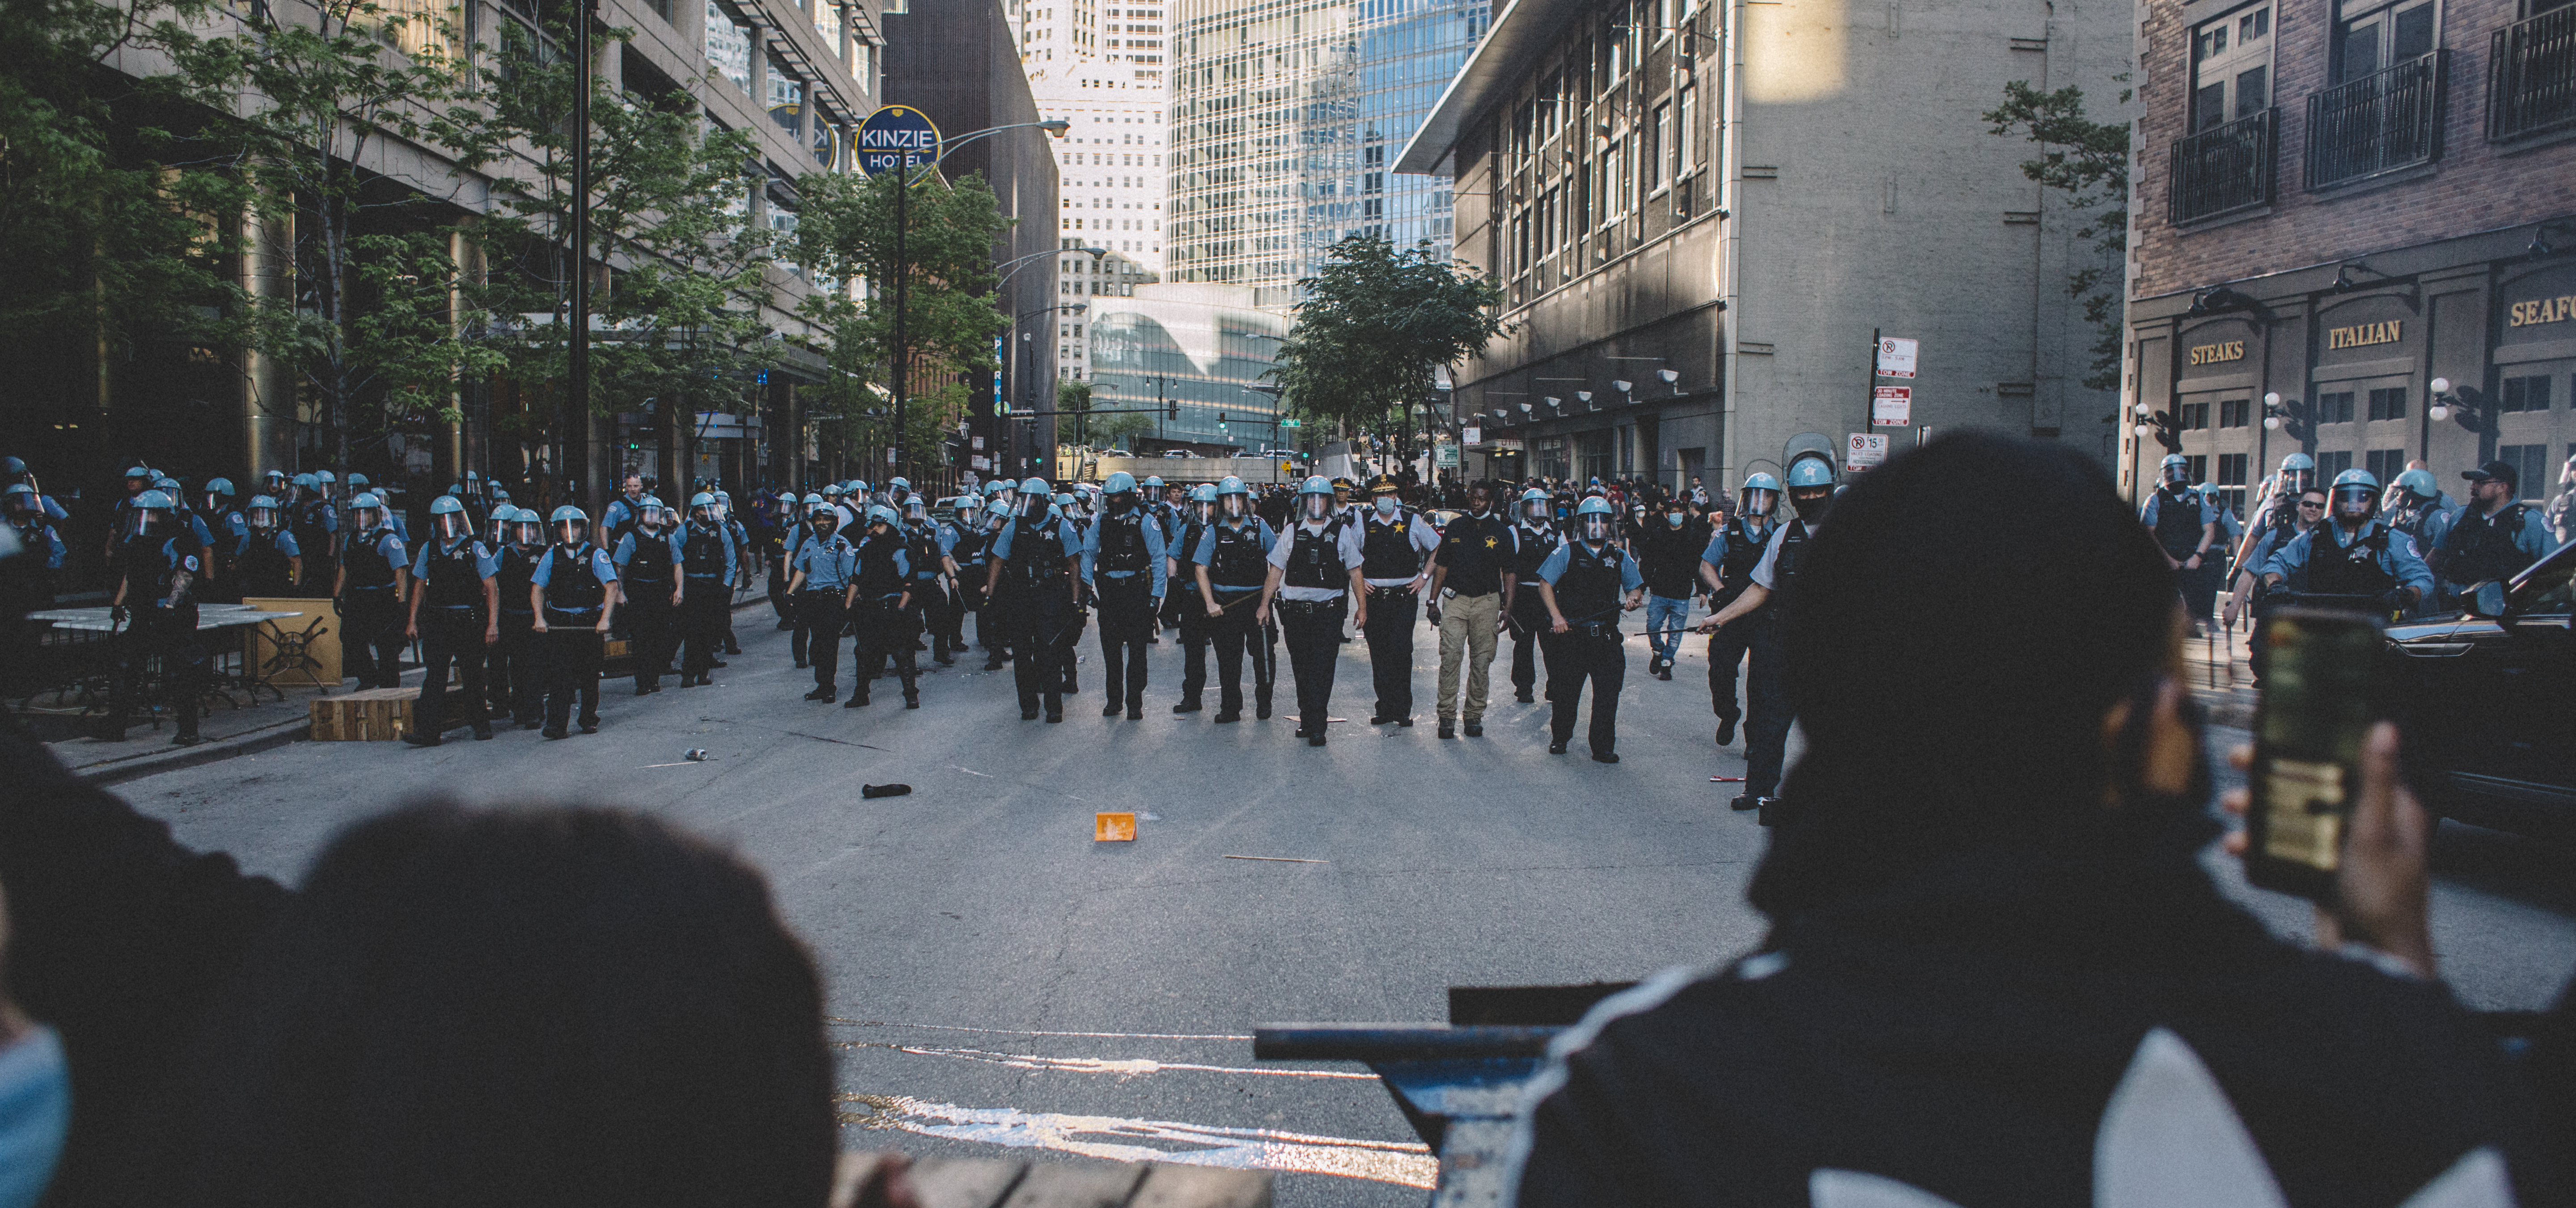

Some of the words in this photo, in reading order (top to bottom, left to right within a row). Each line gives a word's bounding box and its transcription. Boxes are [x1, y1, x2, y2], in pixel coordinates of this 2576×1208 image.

[863, 130, 932, 147] KINZIE
[2329, 320, 2401, 349] ITALIAN
[2191, 340, 2244, 365] STEAKS
